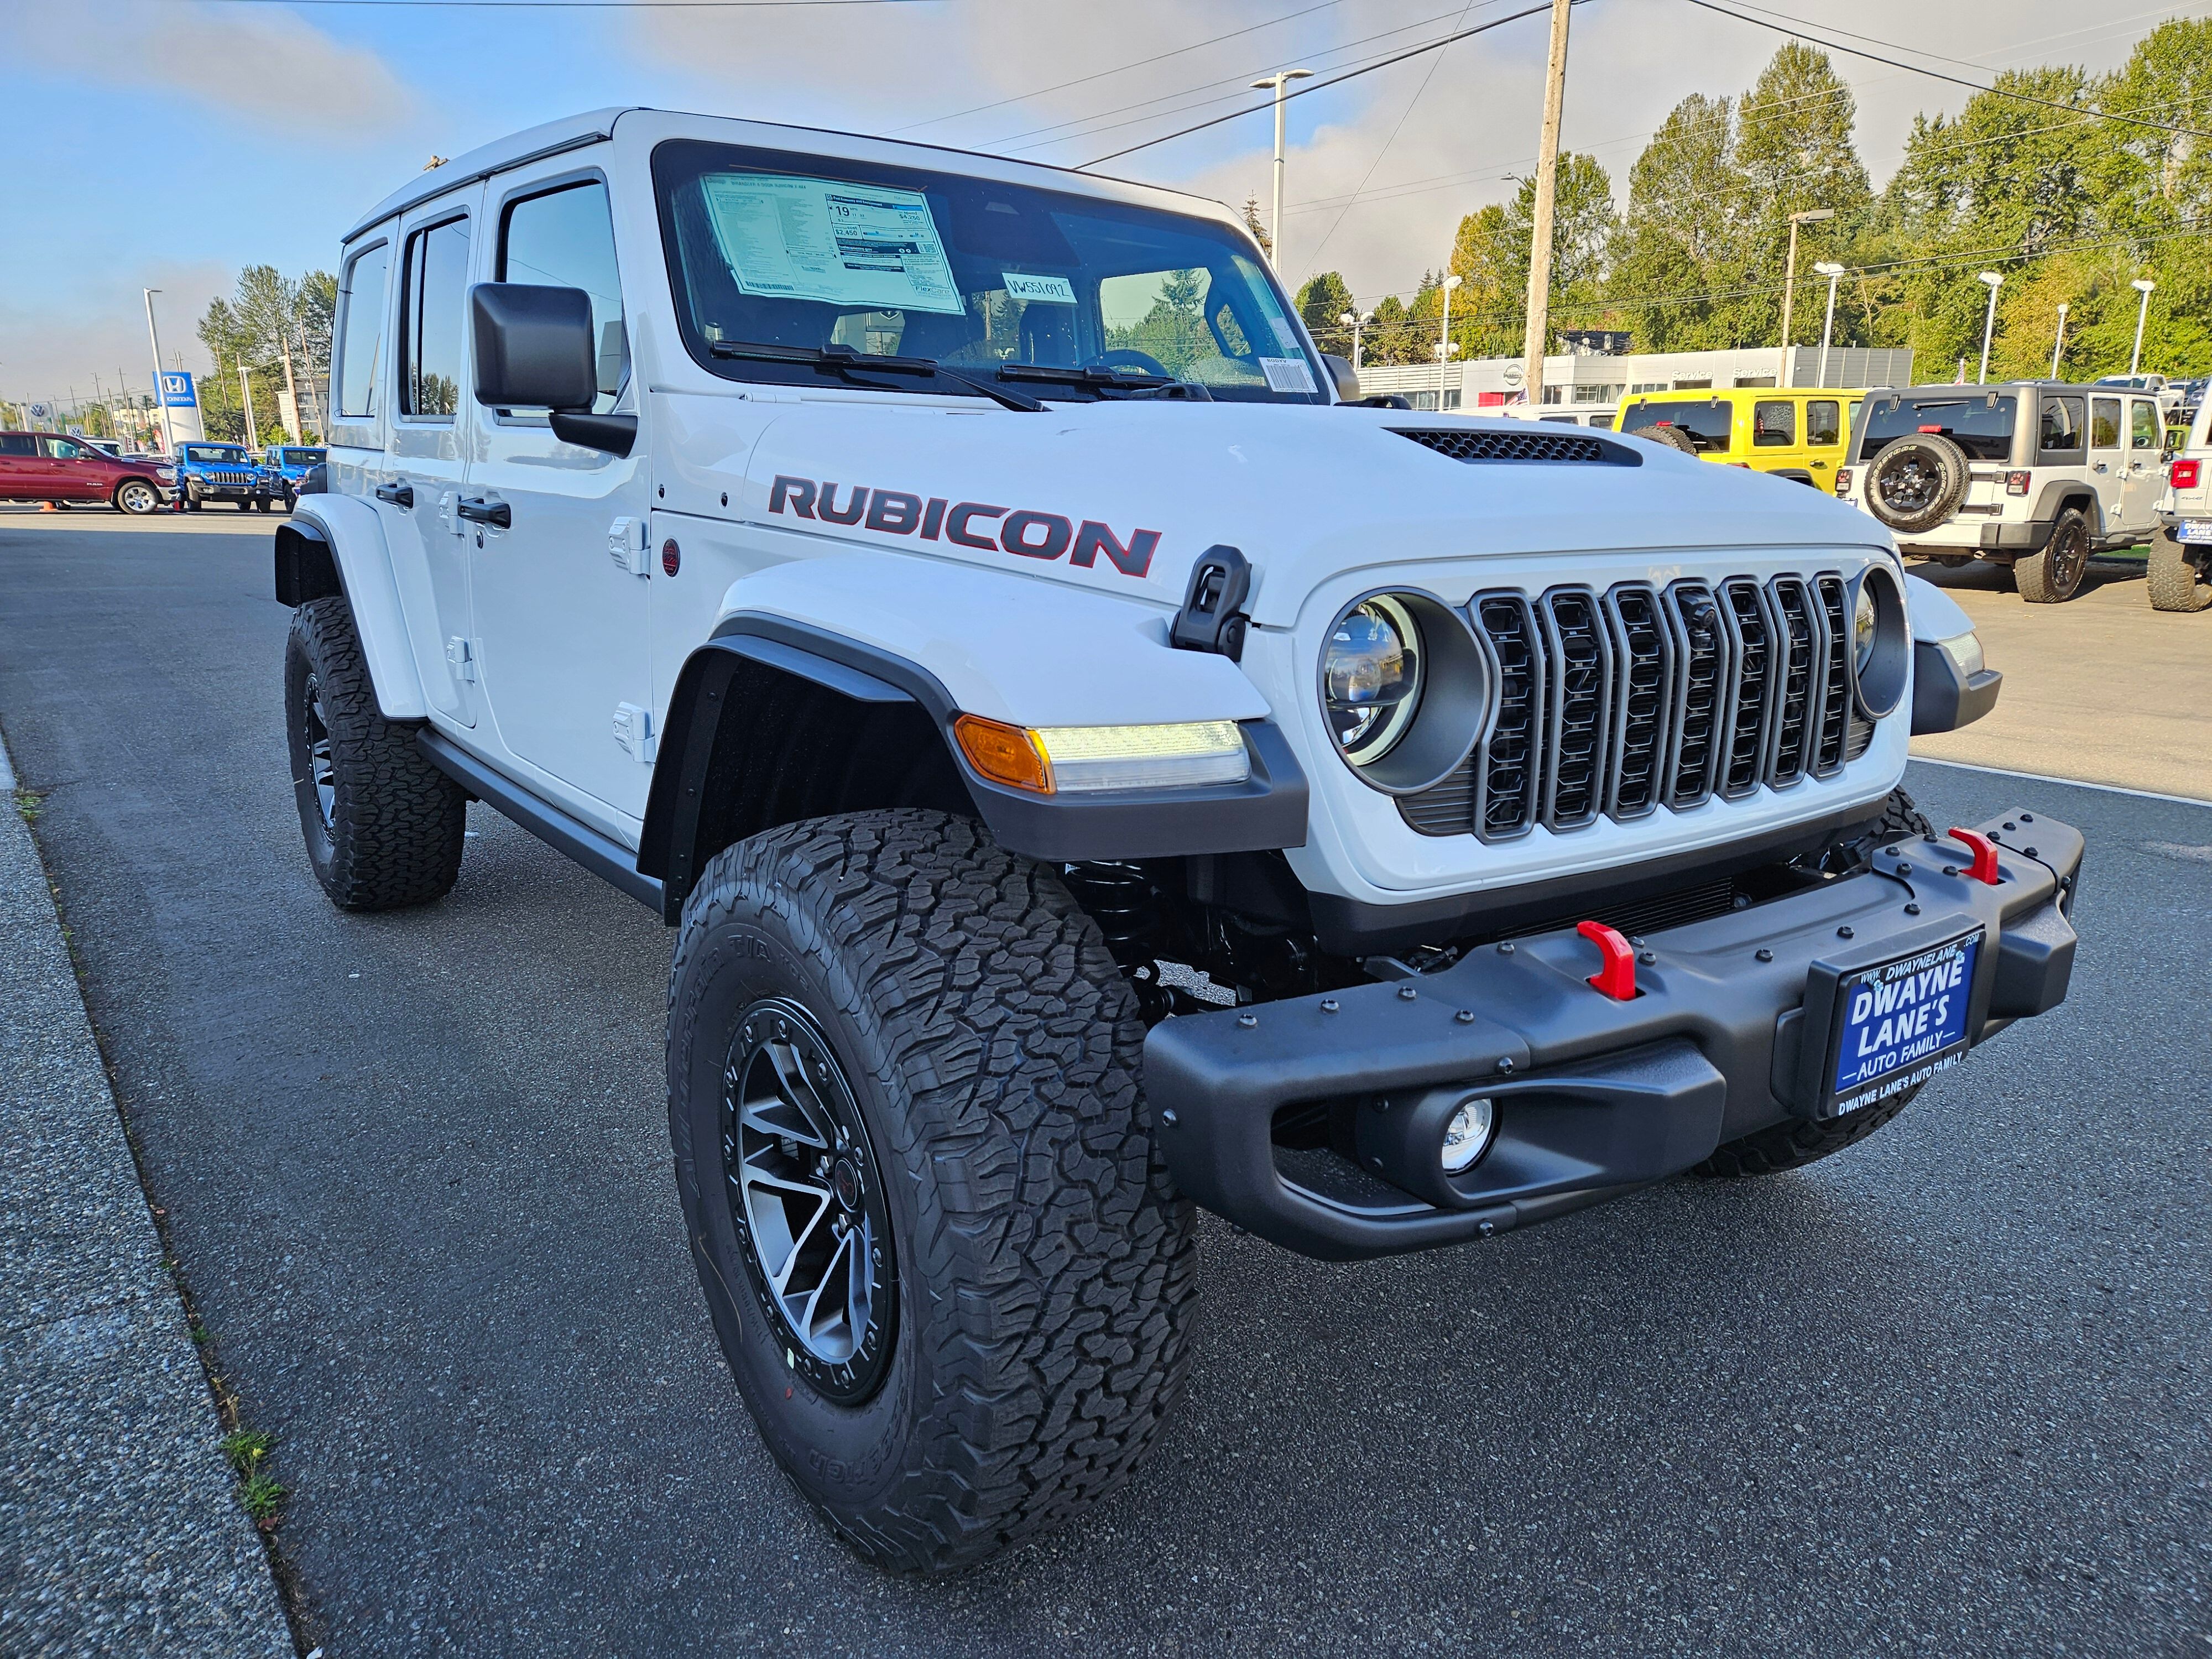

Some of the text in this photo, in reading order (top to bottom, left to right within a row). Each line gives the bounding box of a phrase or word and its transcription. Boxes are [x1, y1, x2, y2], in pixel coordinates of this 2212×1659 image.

[836, 206, 849, 216] 19
[915, 286, 950, 294] FlexCare
[1672, 370, 1714, 380] Service
[1733, 367, 1778, 378] Service
[768, 474, 1162, 578] RUBICON
[1860, 933, 1979, 984] WWW. DWAYNELANE .COM
[1851, 959, 1965, 1025] DWAYNE
[1858, 995, 1950, 1057] LANE'S
[1857, 1030, 1943, 1081] AUTO FAMILY
[1838, 1051, 1963, 1115] DWAYNE LANE'S AUTO FAMILY
